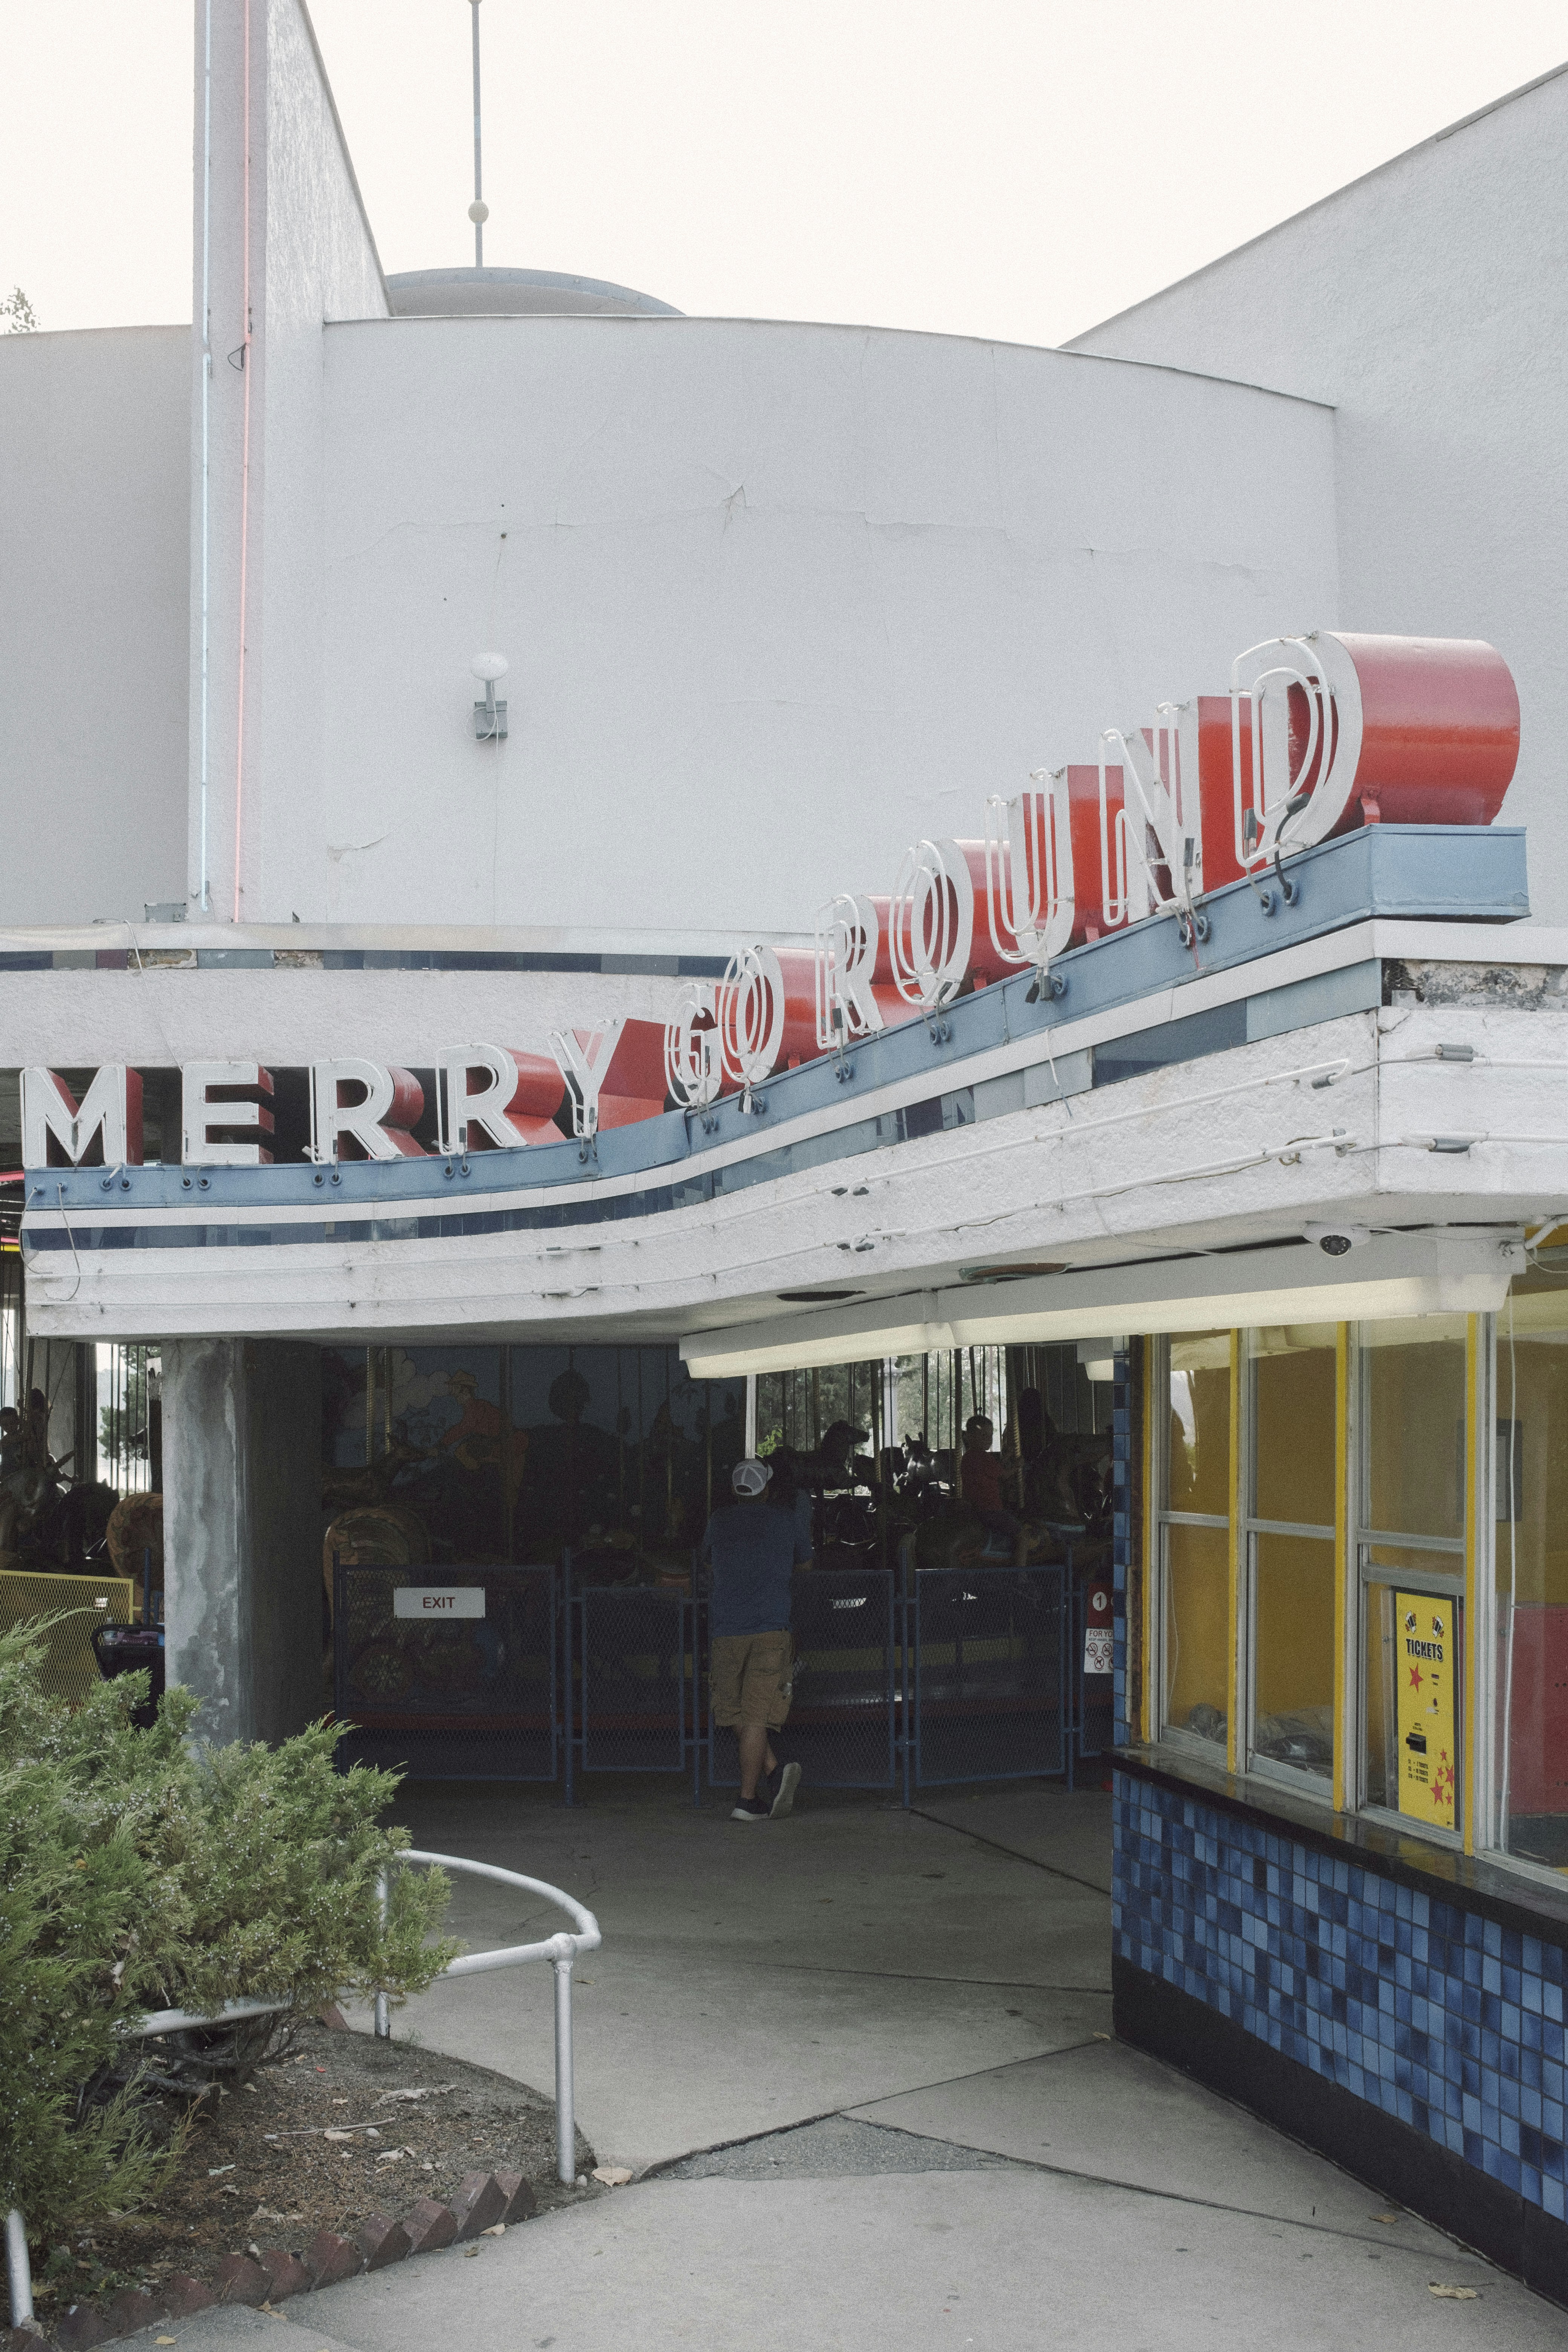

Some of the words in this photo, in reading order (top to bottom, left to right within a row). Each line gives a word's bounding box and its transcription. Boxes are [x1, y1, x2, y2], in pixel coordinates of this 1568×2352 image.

[20, 1019, 626, 1168] MERRY
[663, 946, 786, 1107] GO
[814, 632, 1364, 1049] ROUND
[423, 1597, 456, 1609] EXIT
[1096, 1595, 1101, 1608] 1
[1406, 1638, 1443, 1661] TICKETS
